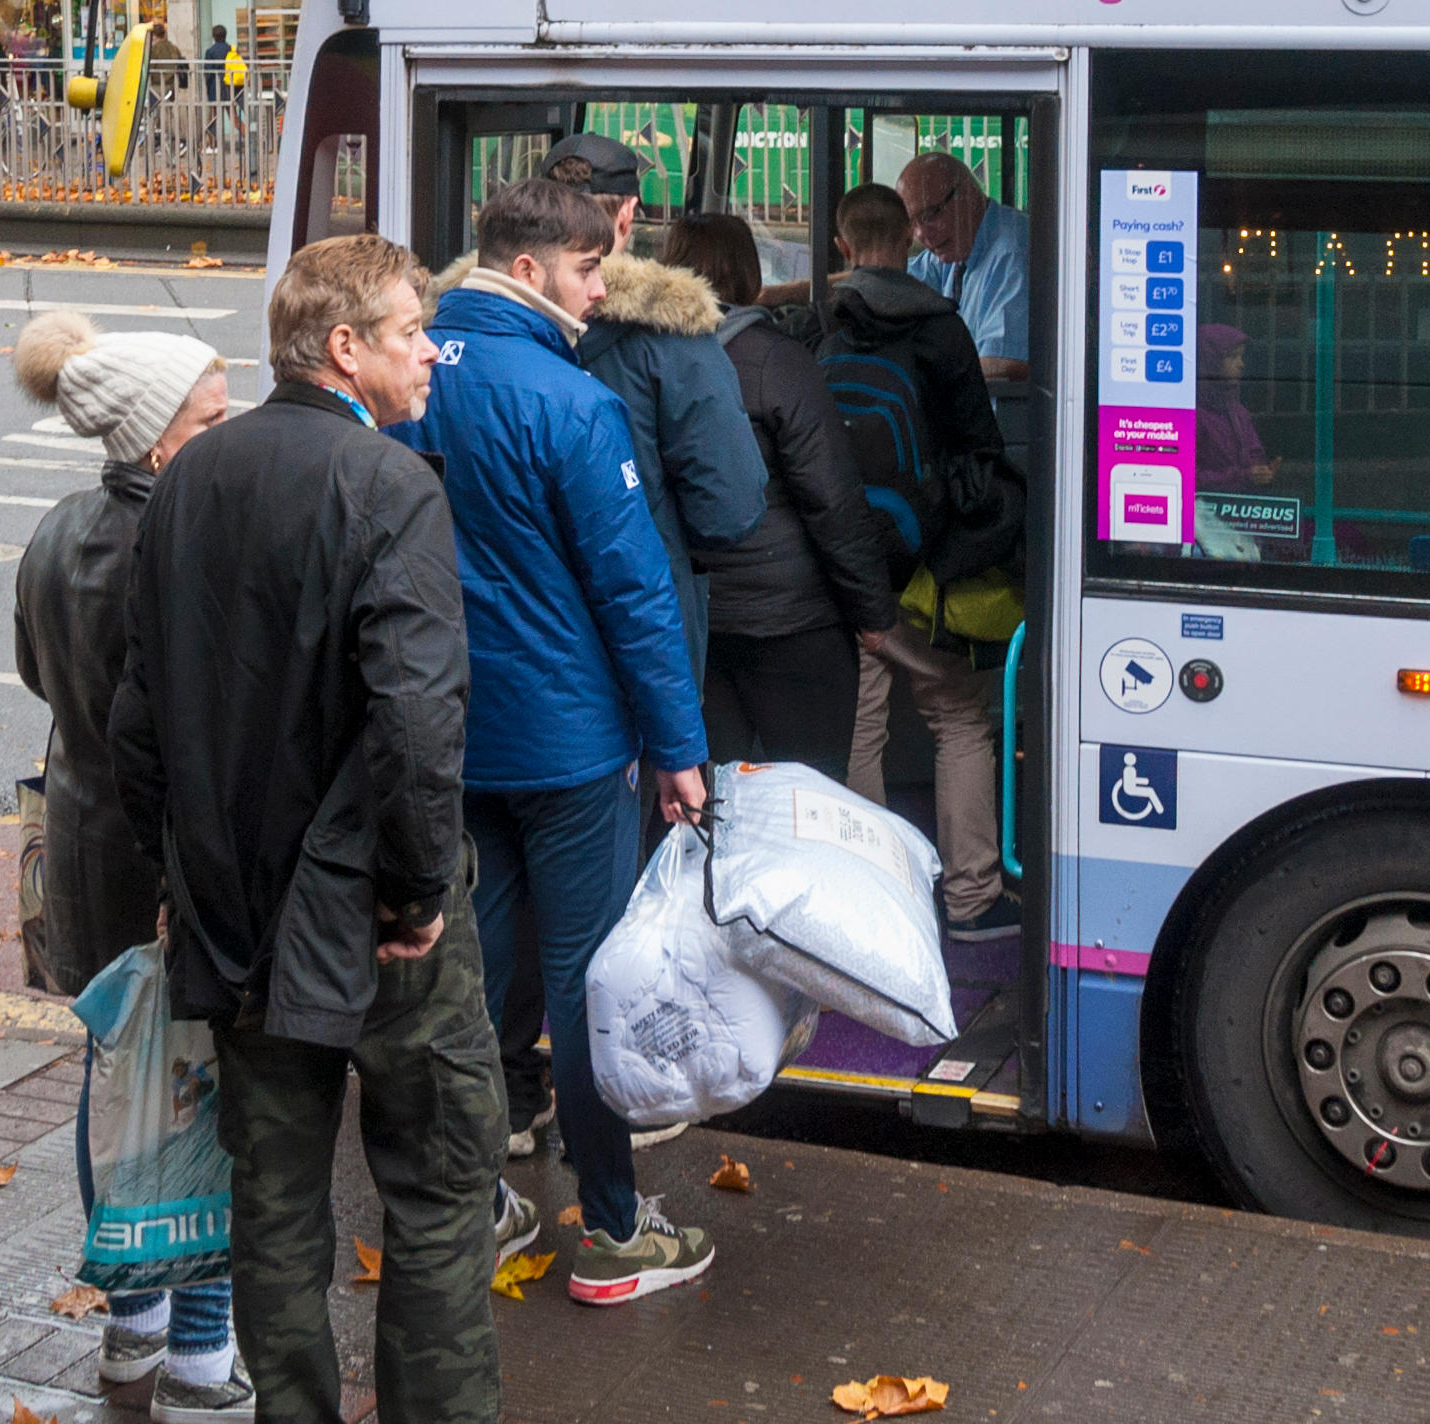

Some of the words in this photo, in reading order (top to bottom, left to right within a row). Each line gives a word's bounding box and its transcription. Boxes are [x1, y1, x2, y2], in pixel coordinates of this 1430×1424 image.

[1132, 184, 1153, 195] First
[1113, 219, 1150, 233] Paying
[1152, 220, 1184, 232] cash?
[1158, 251, 1173, 264] £1
[1156, 360, 1173, 374] £4
[1119, 418, 1132, 428] It's
[1133, 419, 1174, 431] cheapest
[1113, 430, 1125, 438] on
[1126, 431, 1146, 440] your
[1221, 504, 1295, 521] PLUSBUS
